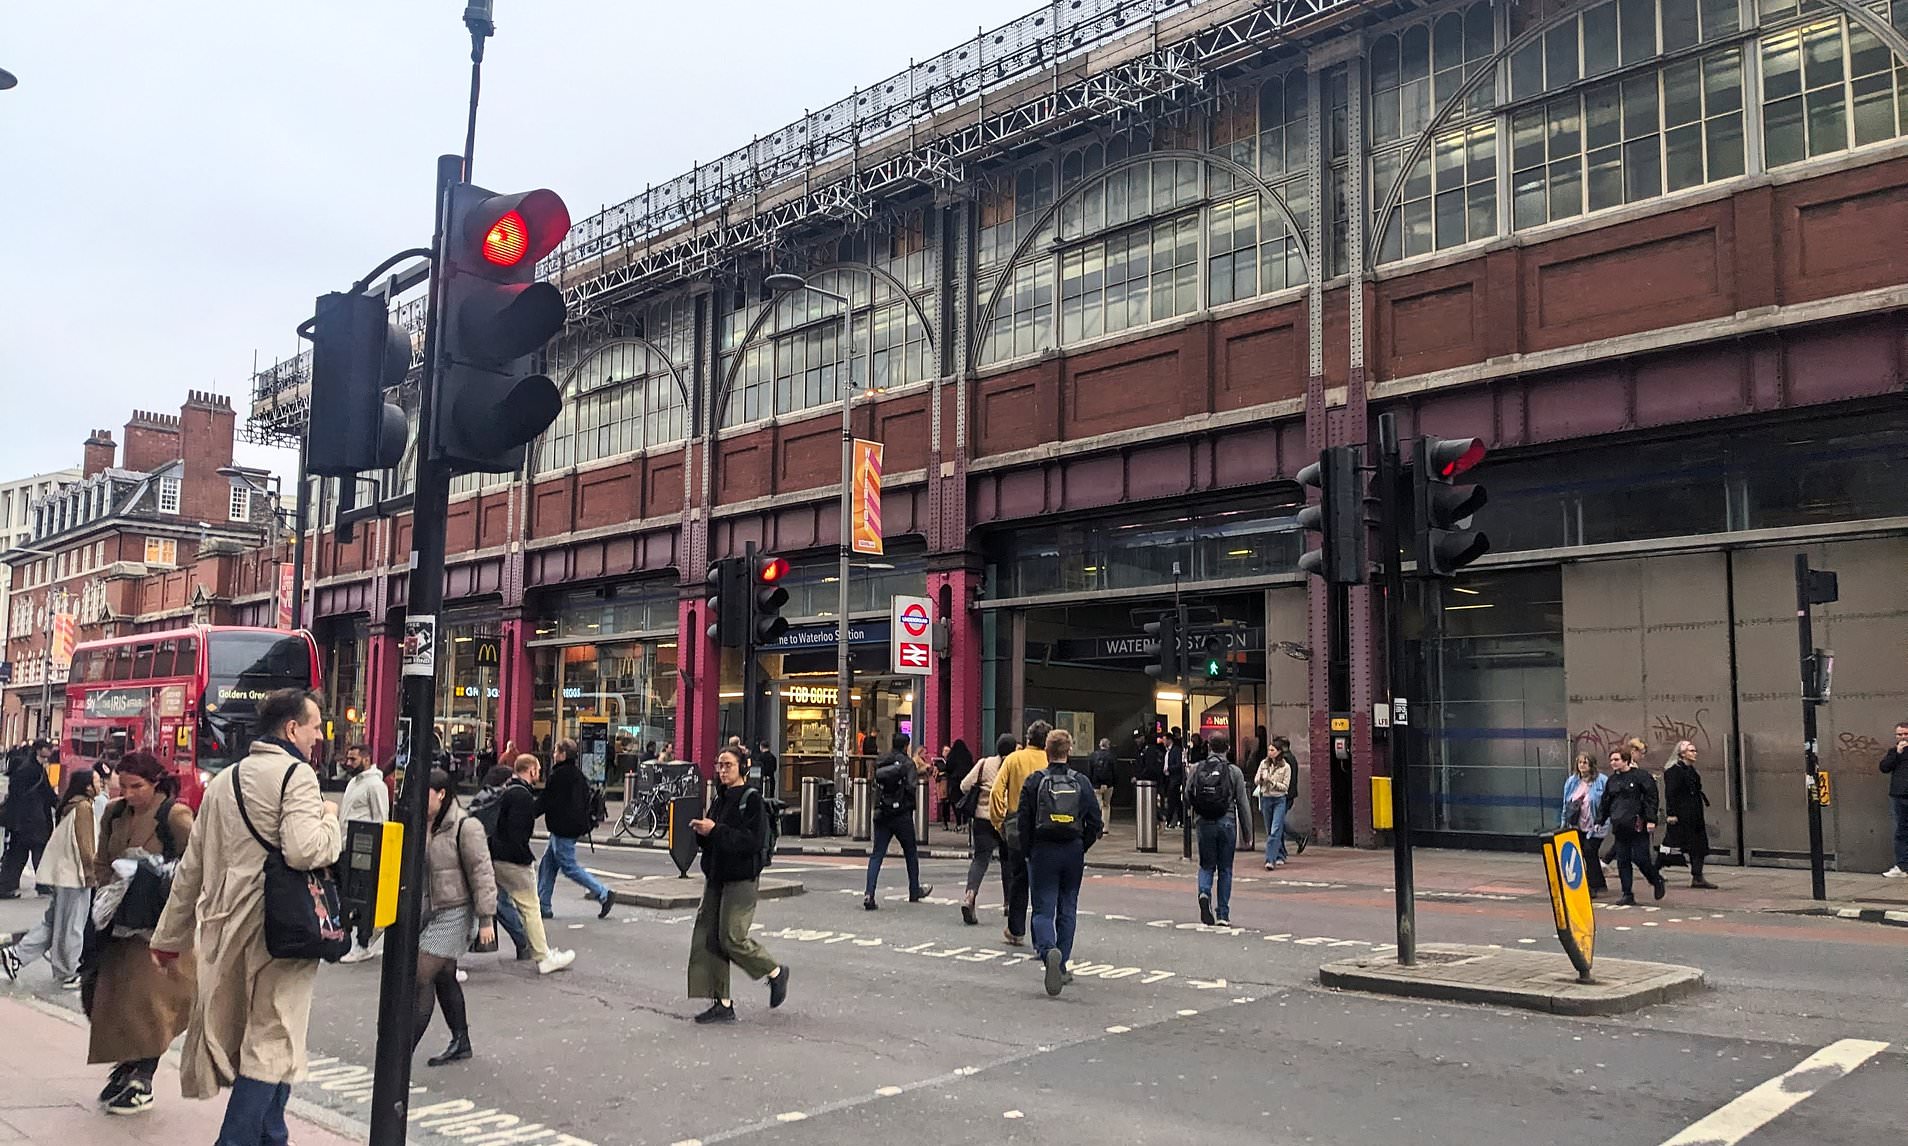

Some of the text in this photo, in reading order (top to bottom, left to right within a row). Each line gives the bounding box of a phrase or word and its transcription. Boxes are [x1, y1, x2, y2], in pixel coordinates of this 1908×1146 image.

[789, 634, 798, 644] to
[799, 631, 833, 643] Waterloo
[835, 628, 864, 641] Stion
[218, 690, 247, 699] Golders
[110, 695, 127, 711] IRIS
